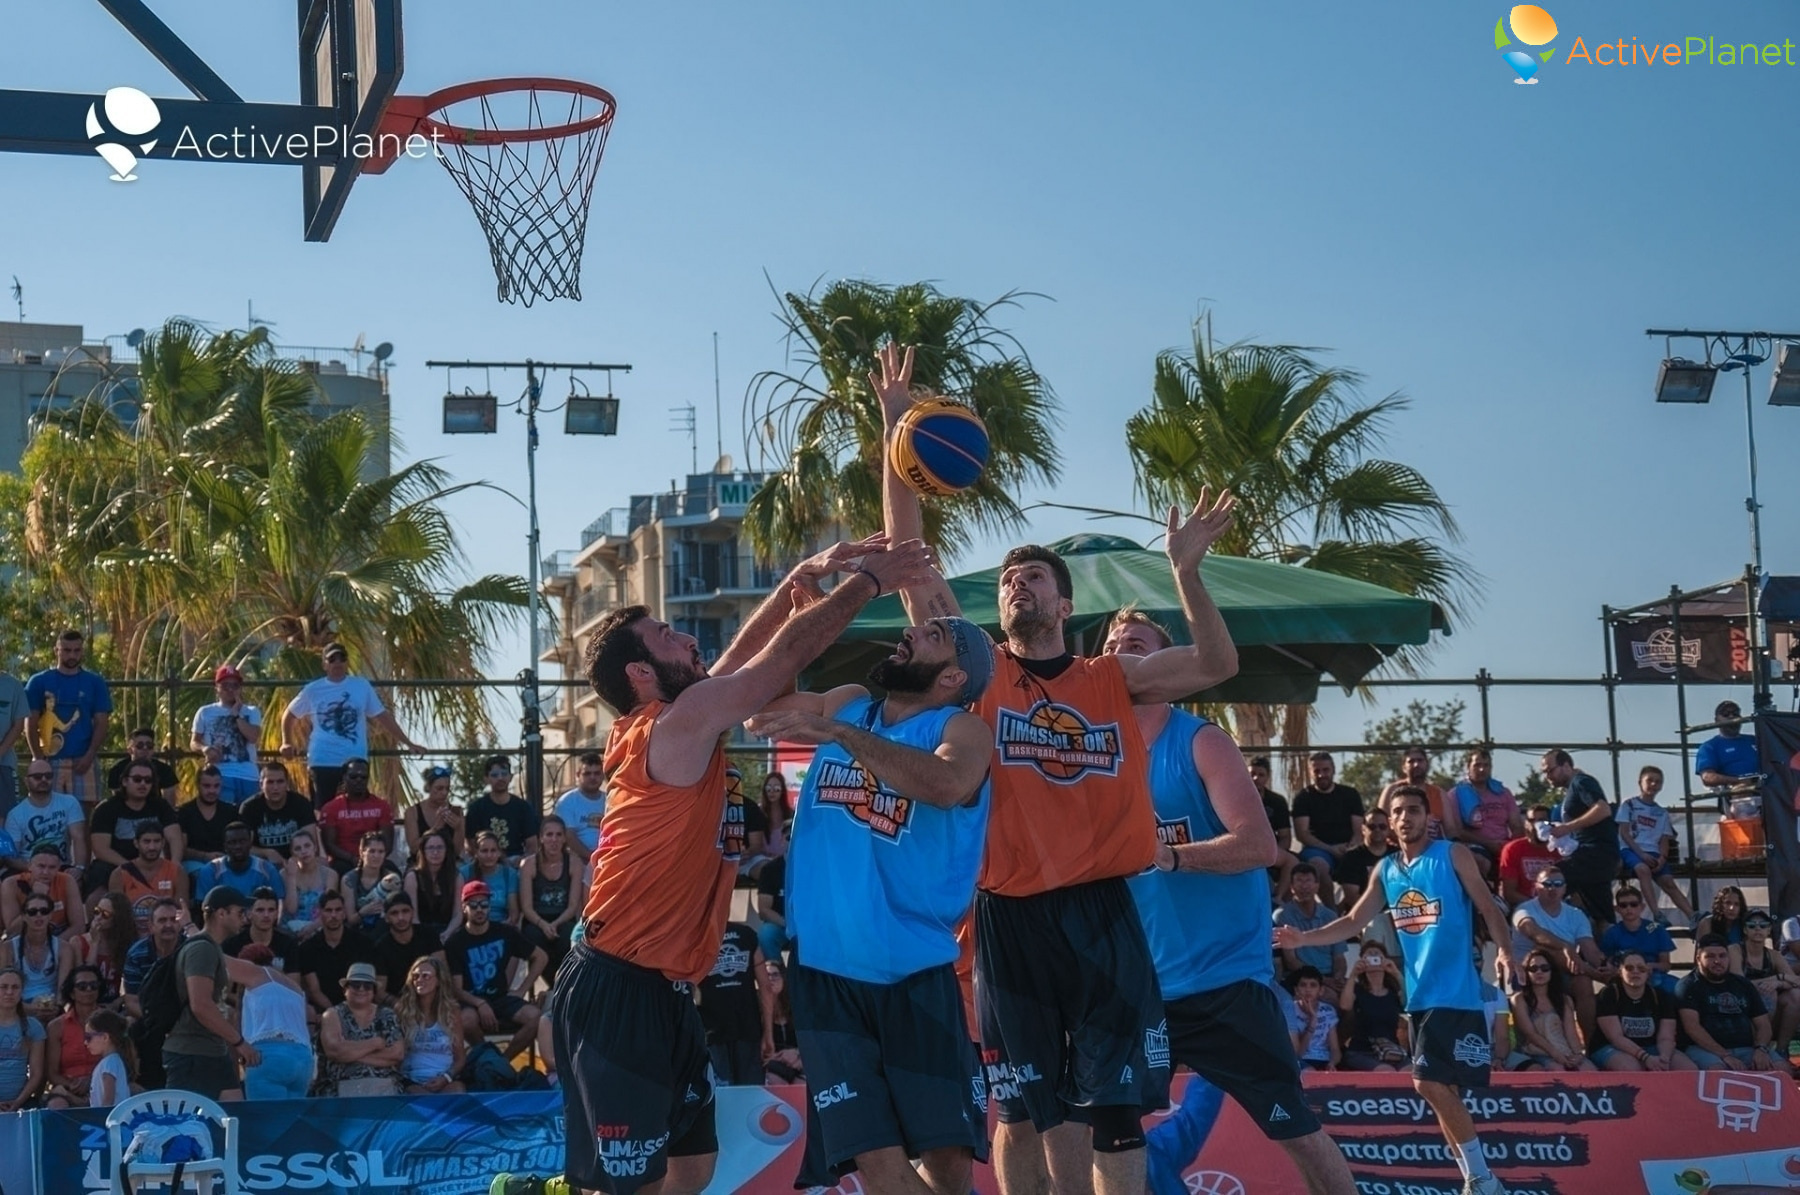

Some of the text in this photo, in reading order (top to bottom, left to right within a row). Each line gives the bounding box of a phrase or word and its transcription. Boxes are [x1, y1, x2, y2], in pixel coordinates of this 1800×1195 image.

[1730, 627, 1747, 672] 2017
[1059, 753, 1110, 766] OURNAMENT
[818, 763, 866, 788] LIMAS
[1157, 824, 1188, 844] ON3
[1462, 1089, 1516, 1120] άρε
[1519, 1089, 1617, 1117] πολλά
[597, 1125, 630, 1138] 2017
[1515, 1135, 1574, 1163] από
